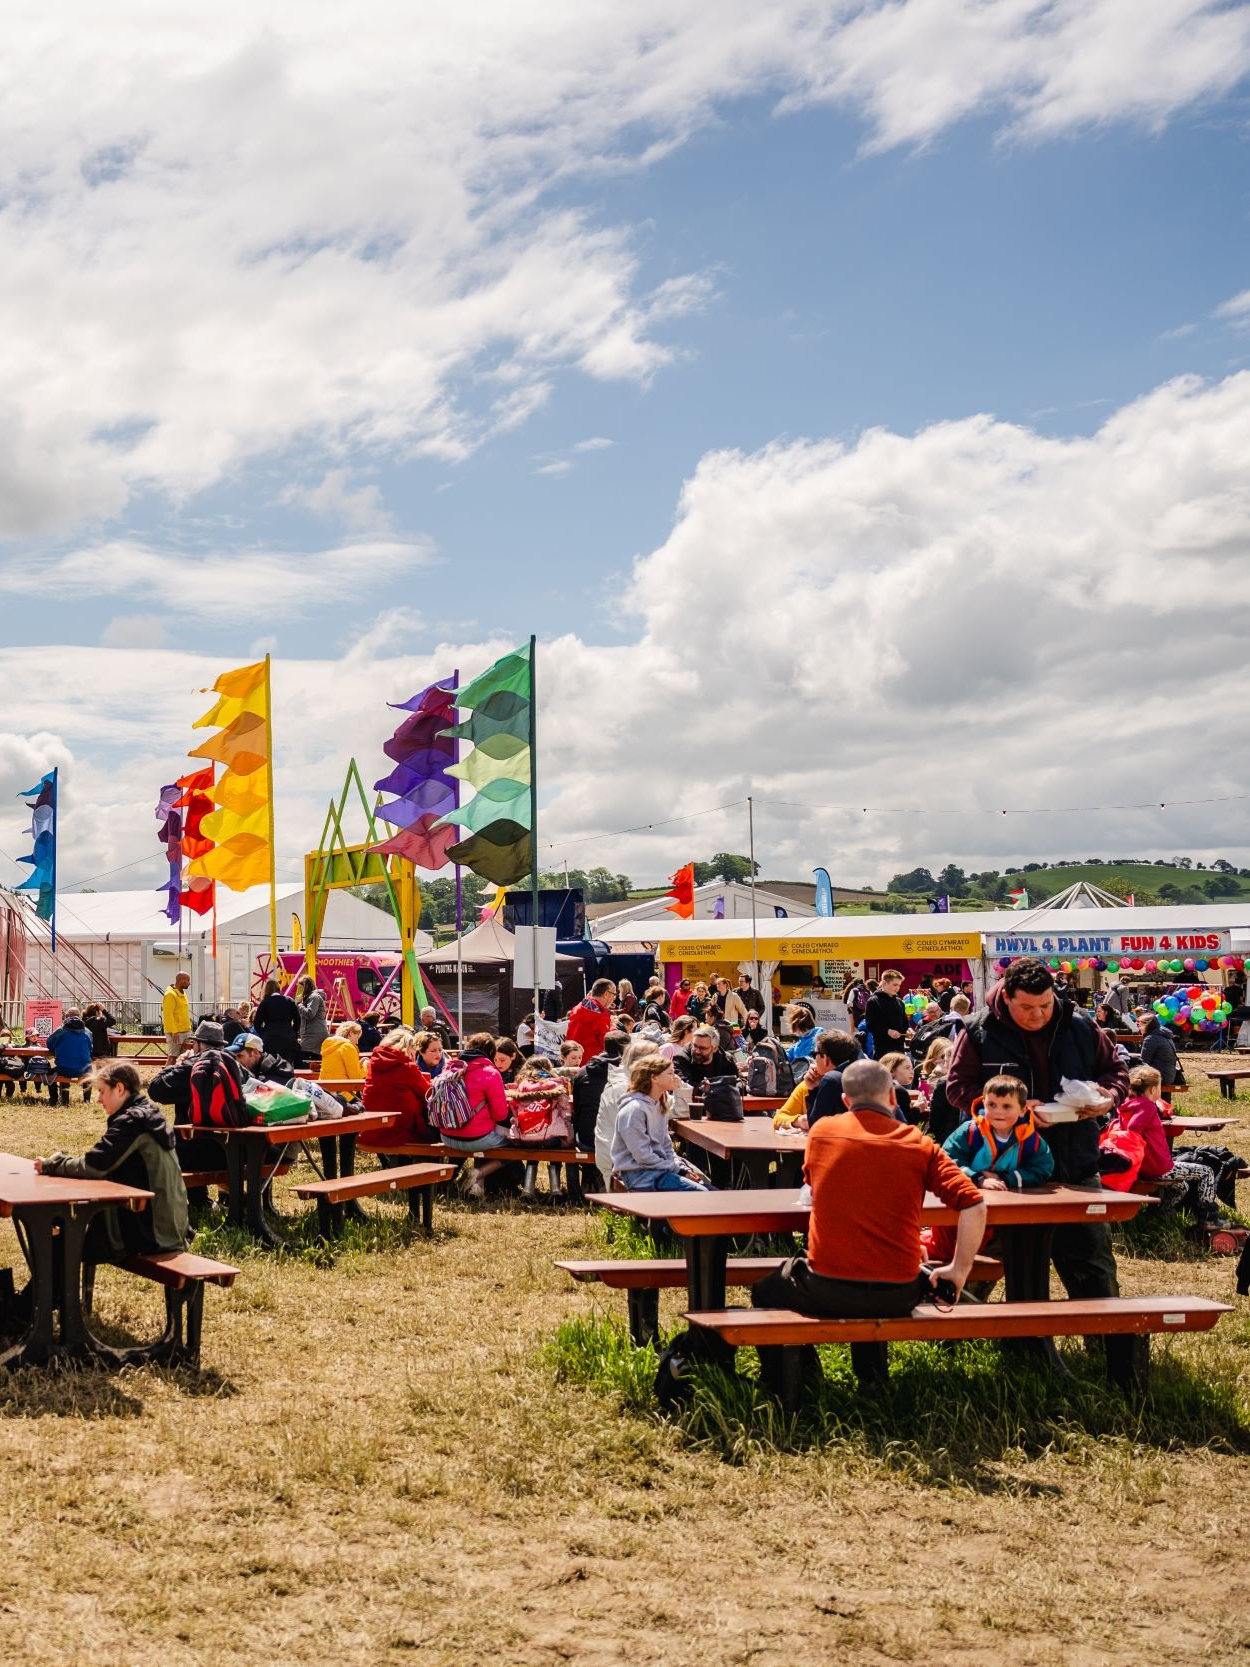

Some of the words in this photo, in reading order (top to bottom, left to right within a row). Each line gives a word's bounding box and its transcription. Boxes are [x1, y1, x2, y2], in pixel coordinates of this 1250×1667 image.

[995, 937, 1038, 953] HWYL
[1042, 937, 1054, 953] 4
[1057, 937, 1111, 953] PLANT
[1120, 935, 1155, 951] FUN
[1159, 935, 1172, 950] 4
[1176, 934, 1220, 951] KIDS
